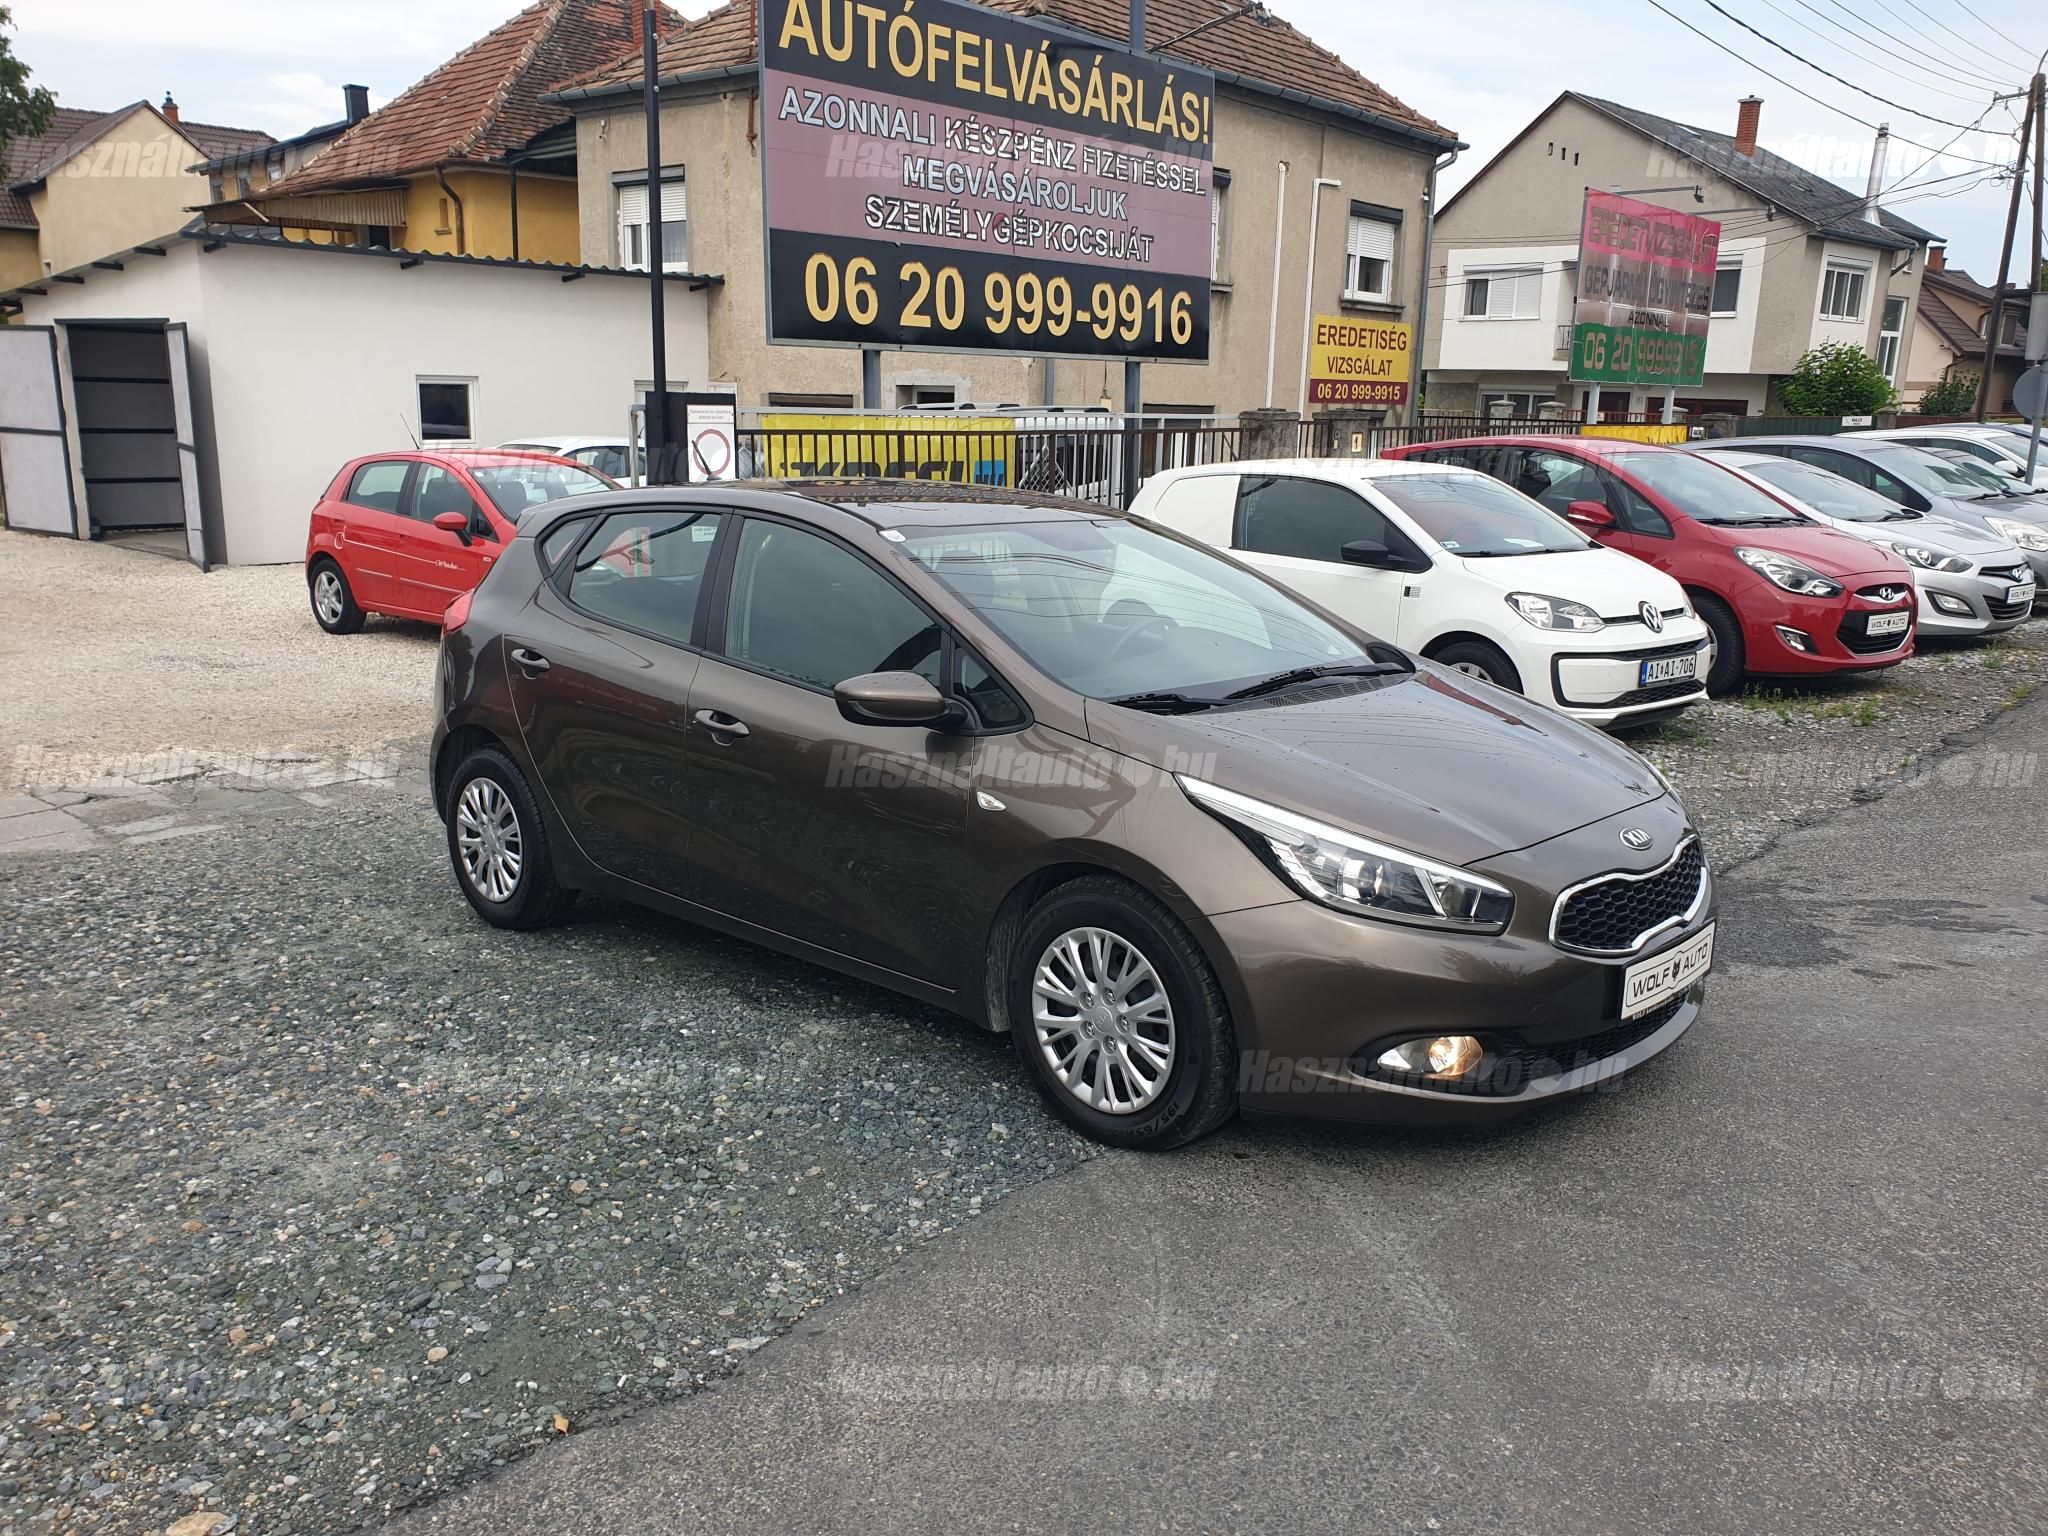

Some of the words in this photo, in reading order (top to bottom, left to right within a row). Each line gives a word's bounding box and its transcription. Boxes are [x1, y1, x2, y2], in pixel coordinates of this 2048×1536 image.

[779, 0, 1209, 144] AUTÓFELVÁSÁRLÁS!
[779, 87, 936, 145] AZONNALI
[944, 115, 1076, 171] KÉSZPÉNZ
[1082, 147, 1207, 196] FIZETÉSSEL
[903, 155, 1128, 221] MEGVÁSÁROLJUK
[865, 196, 1154, 263] SZEMÉLYGÉPKOCSIJÁT
[804, 253, 880, 325] 06
[899, 262, 966, 331] 20
[984, 271, 1193, 345] 999-9916
[1317, 323, 1407, 351] EREDETISÉG
[1583, 332, 1607, 369] 06
[1611, 335, 1632, 371] 20
[1327, 354, 1393, 376] VIZSGÁLAT
[1317, 383, 1332, 399] 06
[1334, 384, 1349, 399] 20
[1351, 385, 1401, 400] 999-9915
[1871, 620, 1887, 629] WOLF
[1891, 617, 1906, 626] AUTO
[1623, 828, 1651, 846] KIA
[1632, 967, 1670, 998] WOLF
[1682, 942, 1708, 974] AUTO
